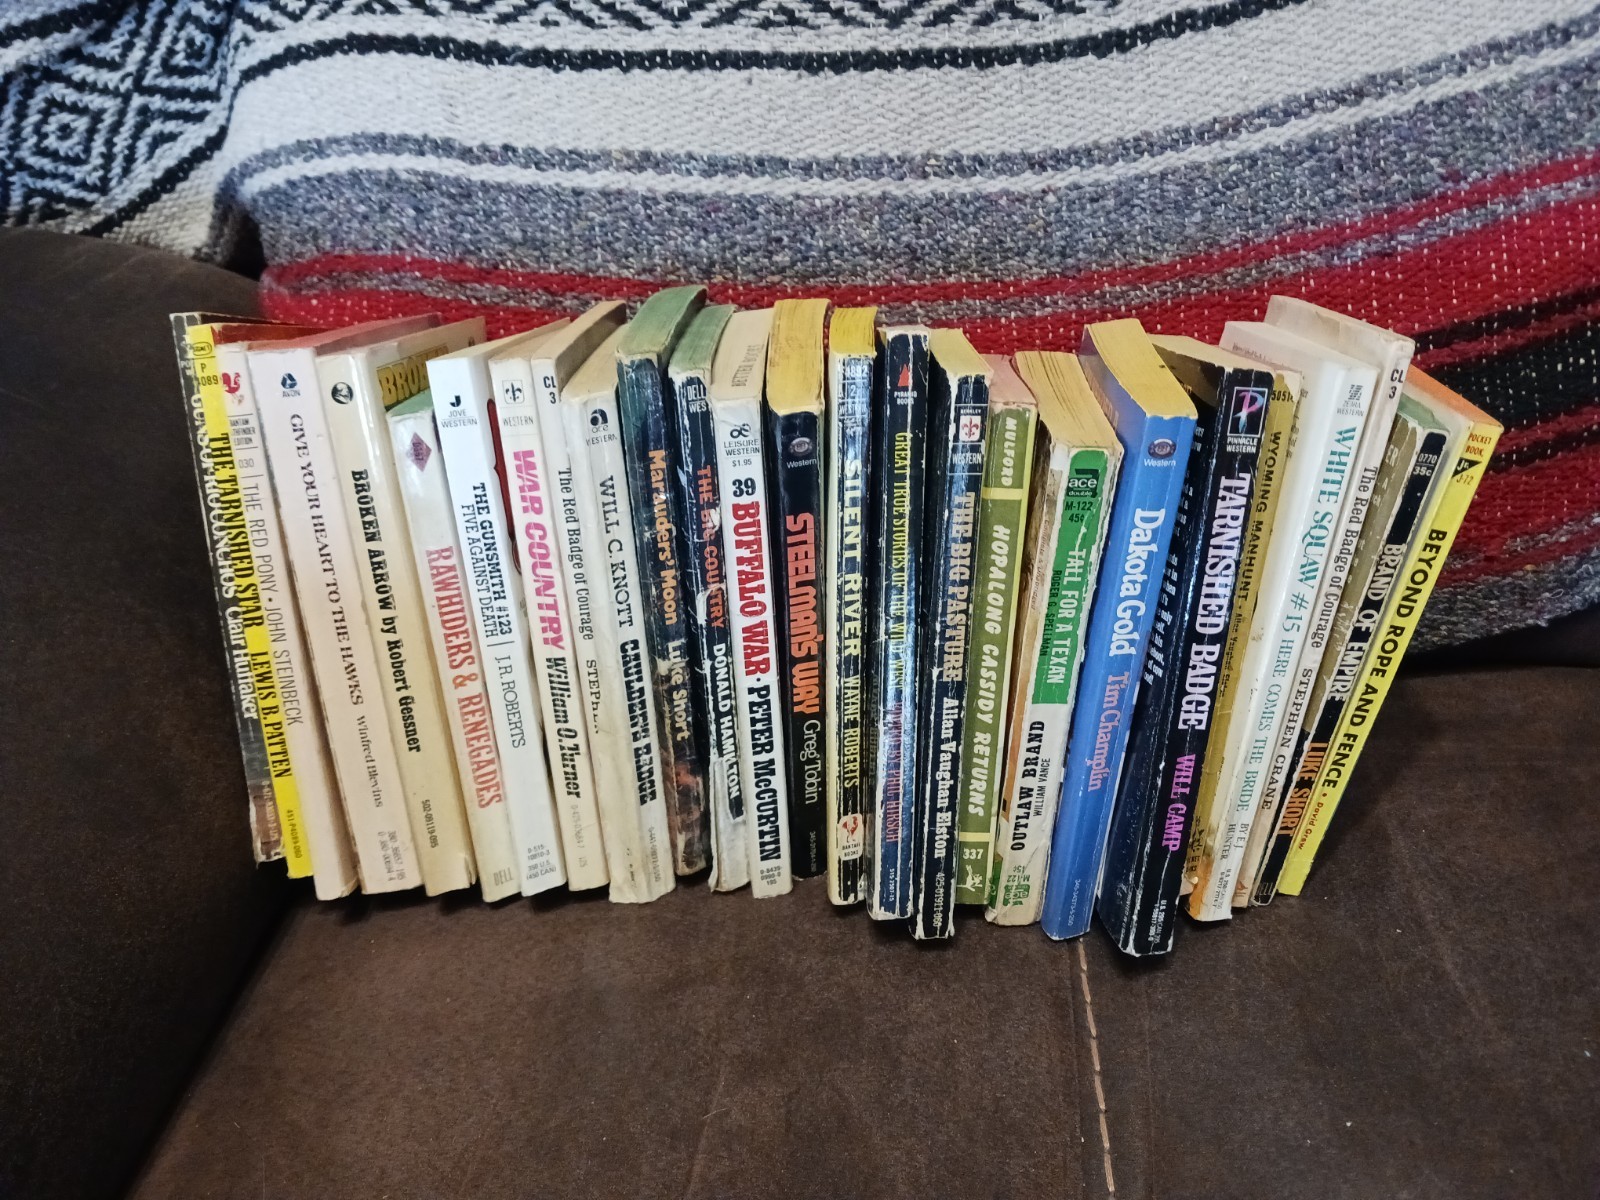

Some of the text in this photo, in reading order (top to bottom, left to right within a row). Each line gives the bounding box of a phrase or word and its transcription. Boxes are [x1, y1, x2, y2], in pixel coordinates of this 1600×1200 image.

[201, 363, 207, 373] P
[282, 390, 301, 398] AVON
[543, 376, 557, 389] CL
[687, 384, 706, 401] DELL
[1389, 386, 1397, 399] 3
[1391, 368, 1404, 383] CL
[441, 418, 478, 428] WESTERN
[449, 409, 467, 418] JOVE
[503, 416, 534, 427] WESTERN
[549, 392, 557, 405] 3
[1336, 408, 1364, 417] WESTERN
[723, 438, 760, 448] LEISURE
[725, 446, 760, 457] WESTERN
[732, 459, 752, 468] $1.95
[786, 457, 817, 470] Western
[895, 432, 912, 474] GREAT
[952, 452, 982, 465] WESTERN
[1001, 416, 1018, 487] MULFORD
[1143, 458, 1177, 467] Western
[1226, 444, 1257, 454] WESTERN
[1227, 437, 1258, 446] PINNACLE
[1468, 432, 1493, 445] POCKET
[513, 449, 544, 516] WAR
[558, 467, 572, 494] The
[732, 477, 757, 498] 39
[893, 482, 910, 515] TRUE
[1068, 478, 1097, 488] ace
[1255, 431, 1282, 513] WYOMING
[209, 432, 264, 628] THE TARNISHED STAR
[562, 497, 579, 524] Red
[1065, 501, 1093, 512] M-122
[209, 509, 237, 598] CONCHOS
[290, 413, 364, 706] GIVE YOUR HEART TO THE HAWKS
[461, 504, 499, 639] FIVE AGAINST DEATH
[473, 482, 513, 636] THE GUNSMITH #123
[567, 528, 584, 570] Badge
[600, 475, 633, 628] WILL C. KNOTT
[697, 464, 725, 628] THE COUNTRY
[844, 459, 862, 656] SILENT RIVER
[892, 516, 909, 569] STORIES
[1237, 519, 1264, 601] MANHUNT
[525, 521, 566, 650] COUNTRY
[573, 572, 588, 585] of
[660, 568, 678, 626] Moon
[1367, 543, 1407, 601] BRAND
[242, 483, 304, 726] THE RED PONY JOHN STEINBECK
[351, 468, 421, 753] BROKEN ARROW by Robert Gessner
[576, 587, 594, 640] Courage
[732, 501, 774, 756] BUFFALO WAR PETER
[786, 512, 824, 714] STEELMAN'S WAY
[1039, 570, 1062, 657] ROGER SPELLMAN
[1046, 549, 1086, 684] TALL FOR A TEXAN
[1178, 472, 1251, 731] TARNISHED BADGE
[1236, 426, 1357, 812] WHITE SQUAW HERE COMES THE BRIDE
[1354, 609, 1379, 633] OF
[1085, 508, 1166, 792] Dakota Gold Tim Champlin
[1261, 466, 1378, 811] The Red Badge of Courage STEPHEN CRANE
[1321, 528, 1448, 789] BEYOND ROPE AND FENCE
[250, 651, 277, 701] LEWIS
[426, 545, 503, 809] RAWHIDERS & RENEGADES
[545, 657, 570, 724] William
[620, 639, 650, 743] CAULDER'S
[667, 640, 691, 742] Luke Short
[934, 491, 976, 859] THE BIG PASTURE Allan Vaughan Elston
[968, 524, 1011, 817] HOPALONG CASSIDY RETURNS
[1328, 641, 1367, 702] EMPIRE
[261, 704, 279, 720] B.
[502, 680, 526, 749] ROBERTS
[713, 643, 740, 800] DONALD HAMILTON
[844, 675, 861, 788] WAYNE ROBERTS
[264, 721, 292, 778] PATTEN
[356, 714, 384, 808] Winfred Blevins
[559, 743, 581, 799] Turner
[633, 742, 657, 806] BADGE
[800, 720, 822, 804] Greg Tobin
[886, 769, 901, 842] PHIL HIRSCH
[1011, 720, 1045, 851] OUTLAW BRAND
[1033, 758, 1051, 817] WILLIAM VANCE
[1162, 753, 1196, 852] WILL CAMP
[1277, 742, 1329, 837] LUKE SHORT
[963, 848, 984, 860] 337
[1220, 823, 1237, 861] HUNTER
[1239, 823, 1250, 835] BY
[1298, 801, 1324, 850] David Grew
[493, 868, 514, 886] DELL
